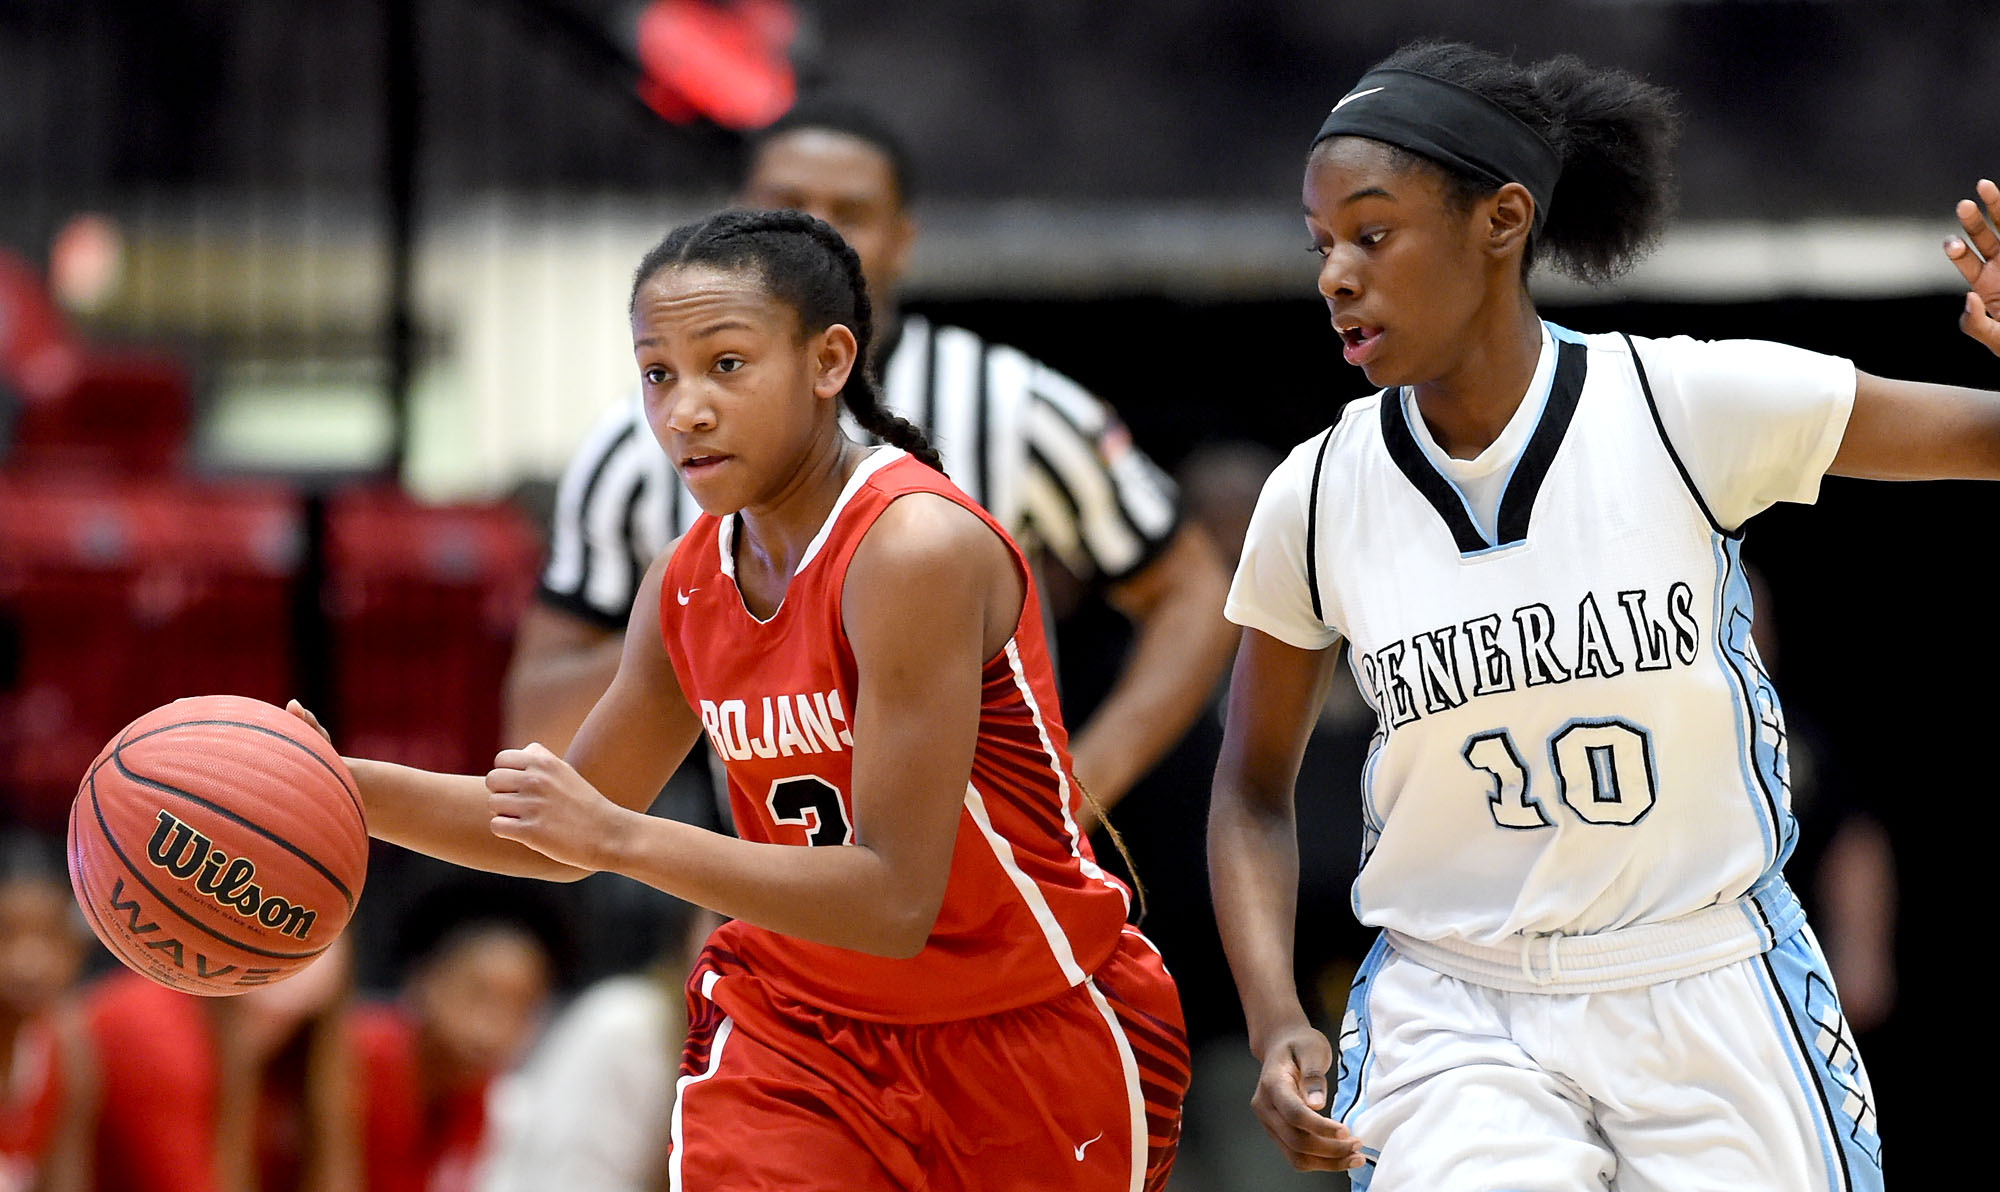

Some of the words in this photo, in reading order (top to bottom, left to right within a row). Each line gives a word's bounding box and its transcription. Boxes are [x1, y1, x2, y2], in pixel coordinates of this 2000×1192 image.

[700, 688, 855, 762] ROJANS
[1460, 714, 1660, 831] 10
[765, 773, 853, 847] 3
[146, 808, 317, 941] Wilson
[110, 876, 280, 986] WAVE
